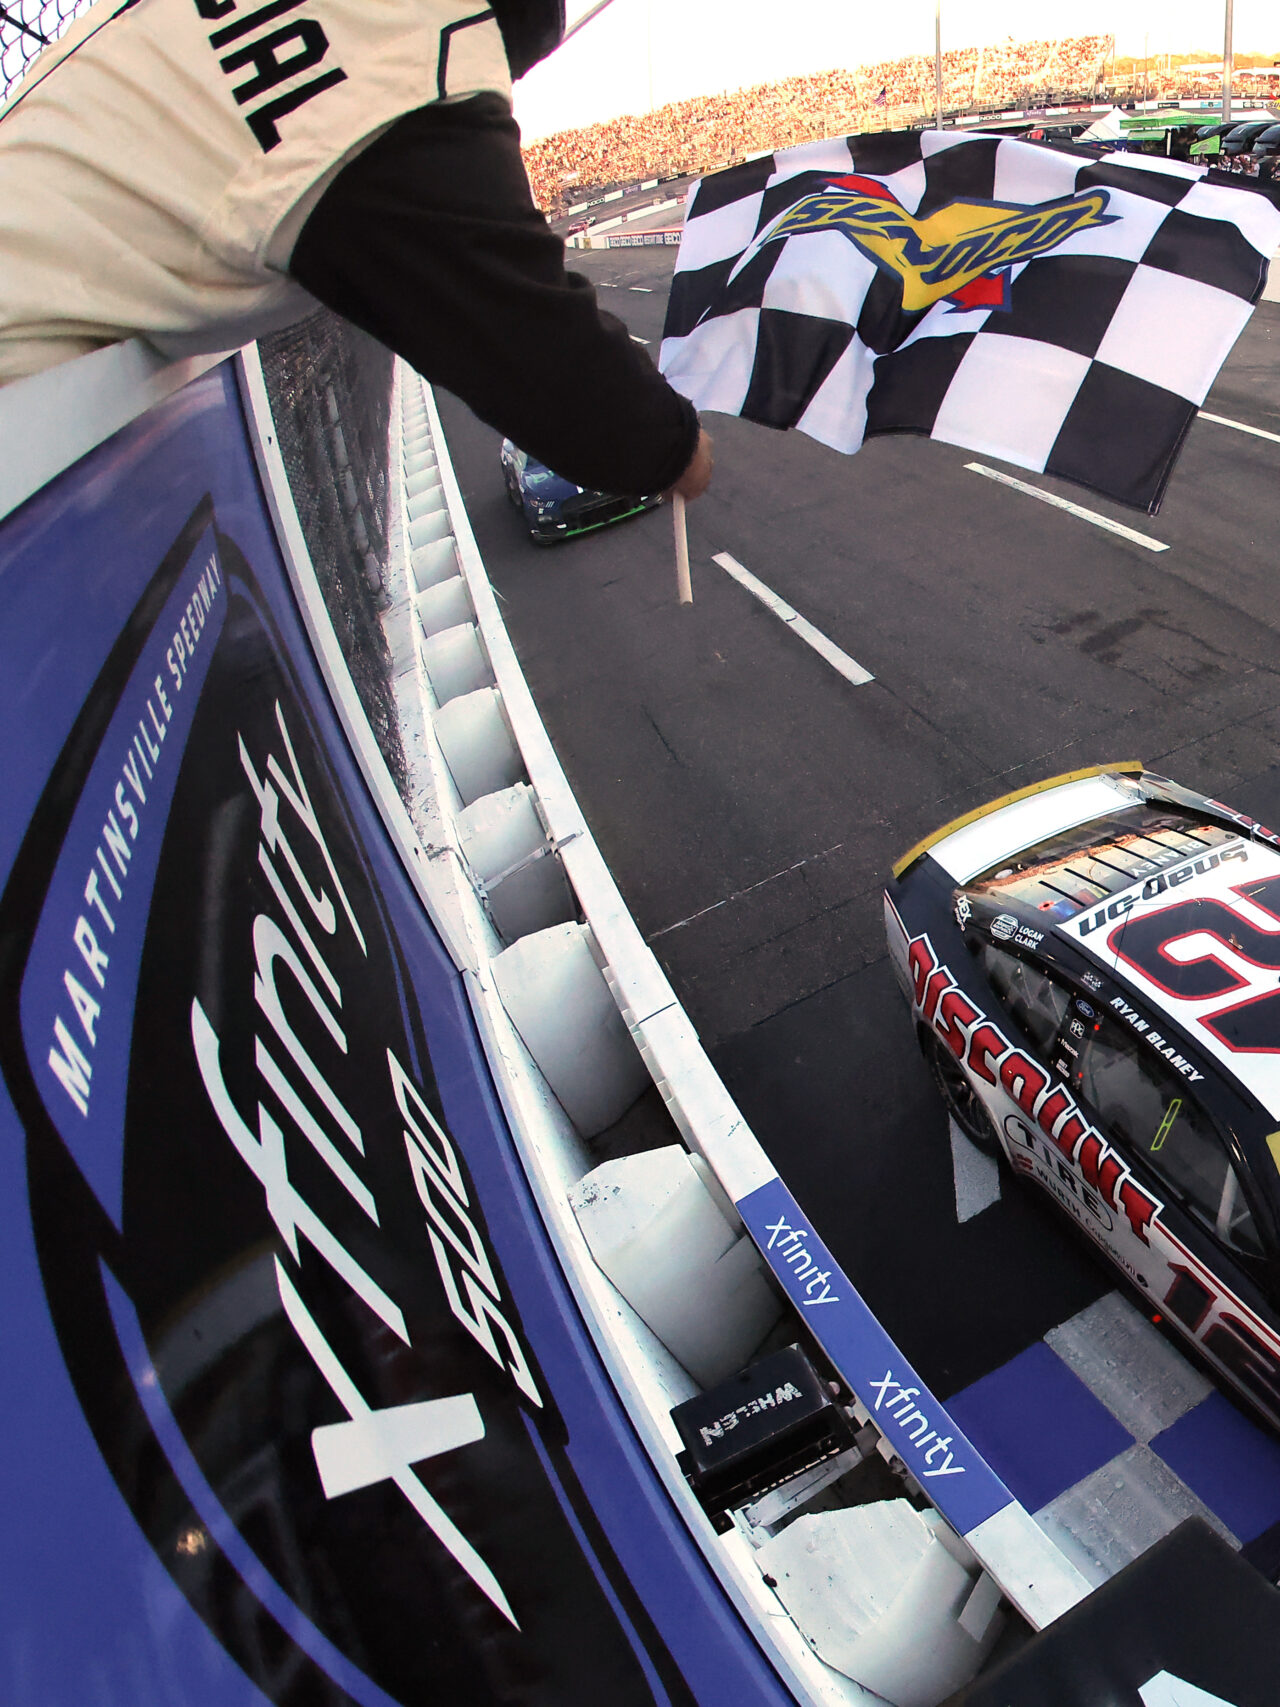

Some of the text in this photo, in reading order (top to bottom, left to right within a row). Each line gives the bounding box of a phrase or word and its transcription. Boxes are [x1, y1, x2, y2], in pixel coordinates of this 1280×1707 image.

[48, 552, 223, 1118] MARTINSVILLE SPEEDWAY
[1129, 839, 1199, 879] BLANEY
[1014, 933, 1039, 950] CLARK
[1018, 925, 1045, 942] LOGAN
[1110, 997, 1205, 1085] RYAN BLANEY
[907, 933, 1166, 1250] DISCOUNT
[191, 697, 521, 1632] xfinity
[1015, 1122, 1102, 1212] TIRE
[387, 1047, 544, 1409] 500
[764, 1215, 840, 1307] xfinity
[699, 1380, 803, 1447] WHELEN
[869, 1370, 967, 1480] xfinity
